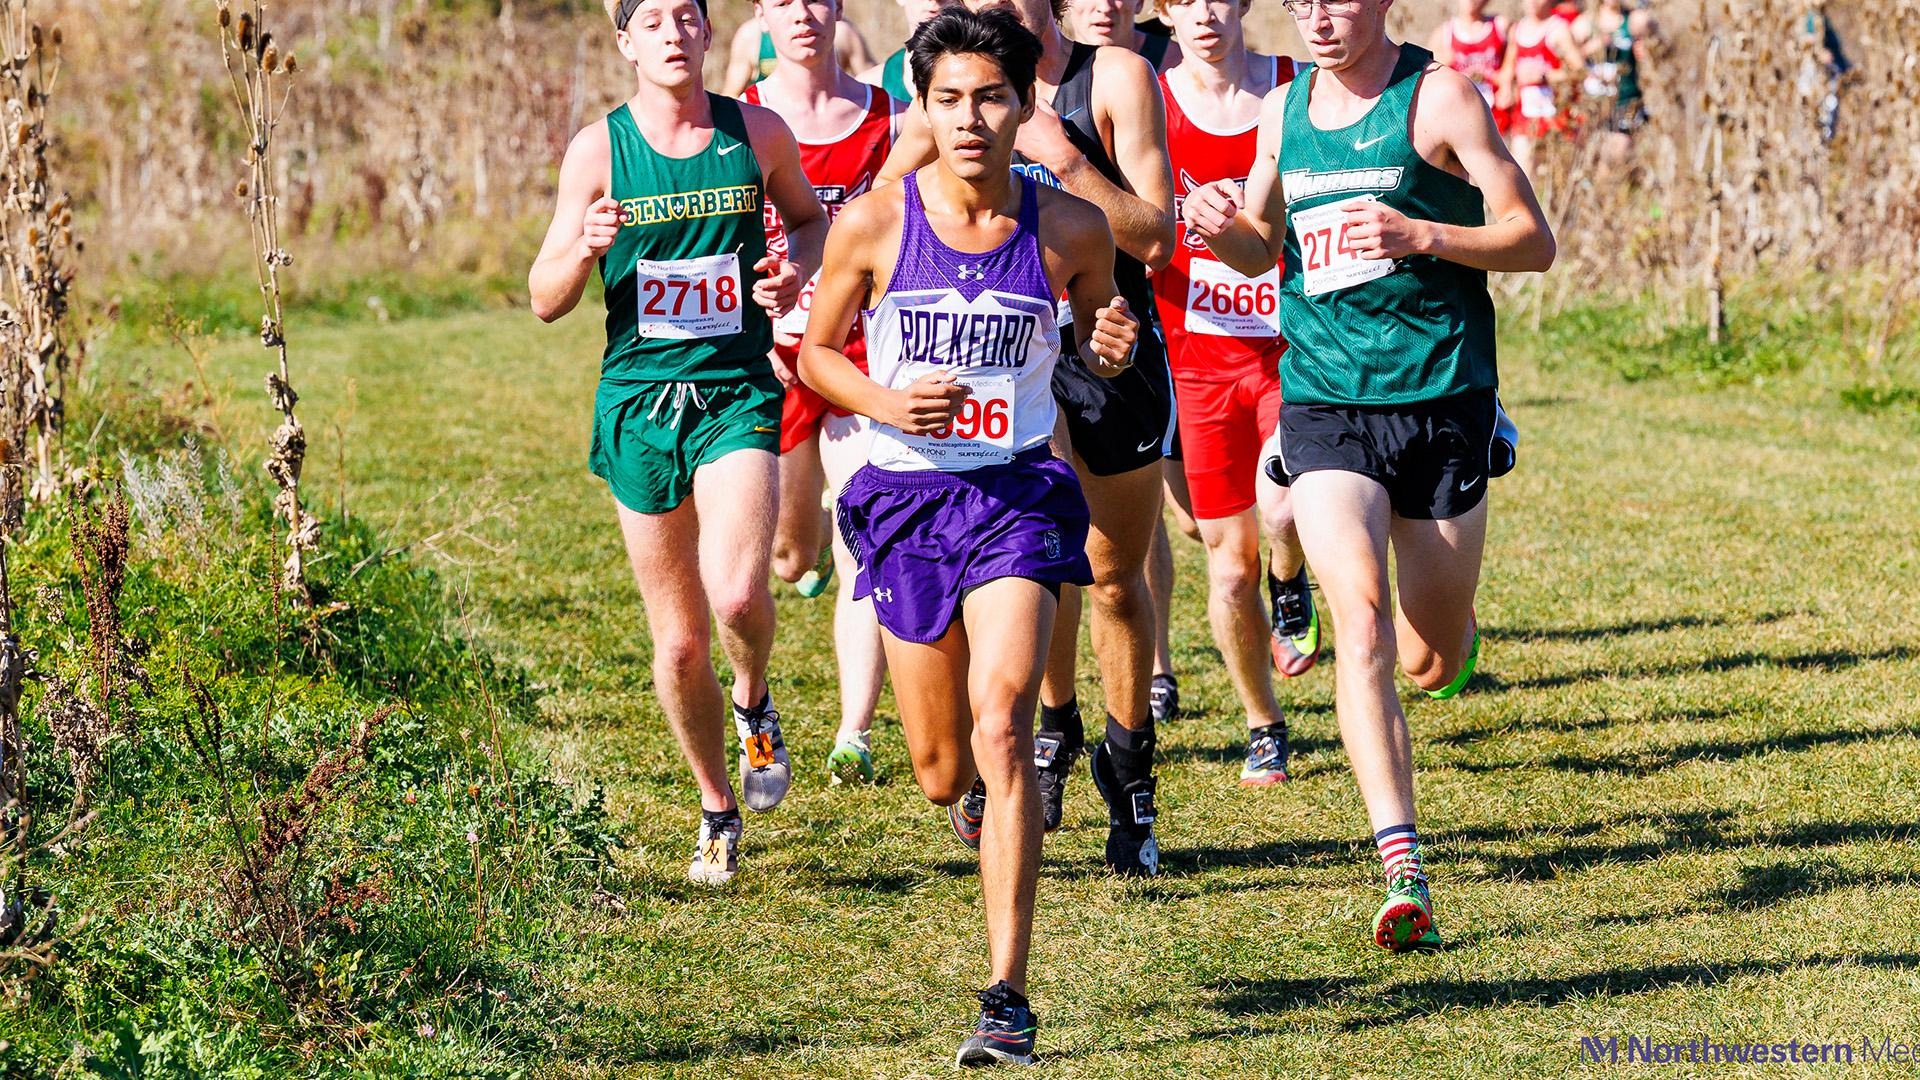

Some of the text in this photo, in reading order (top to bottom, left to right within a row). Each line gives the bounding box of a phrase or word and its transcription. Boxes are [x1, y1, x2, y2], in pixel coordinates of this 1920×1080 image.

[1303, 222, 1358, 272] 274
[643, 275, 737, 316] 2718
[1191, 279, 1276, 317] 2666
[898, 309, 1036, 368] ROCKFORD
[926, 447, 947, 457] POND
